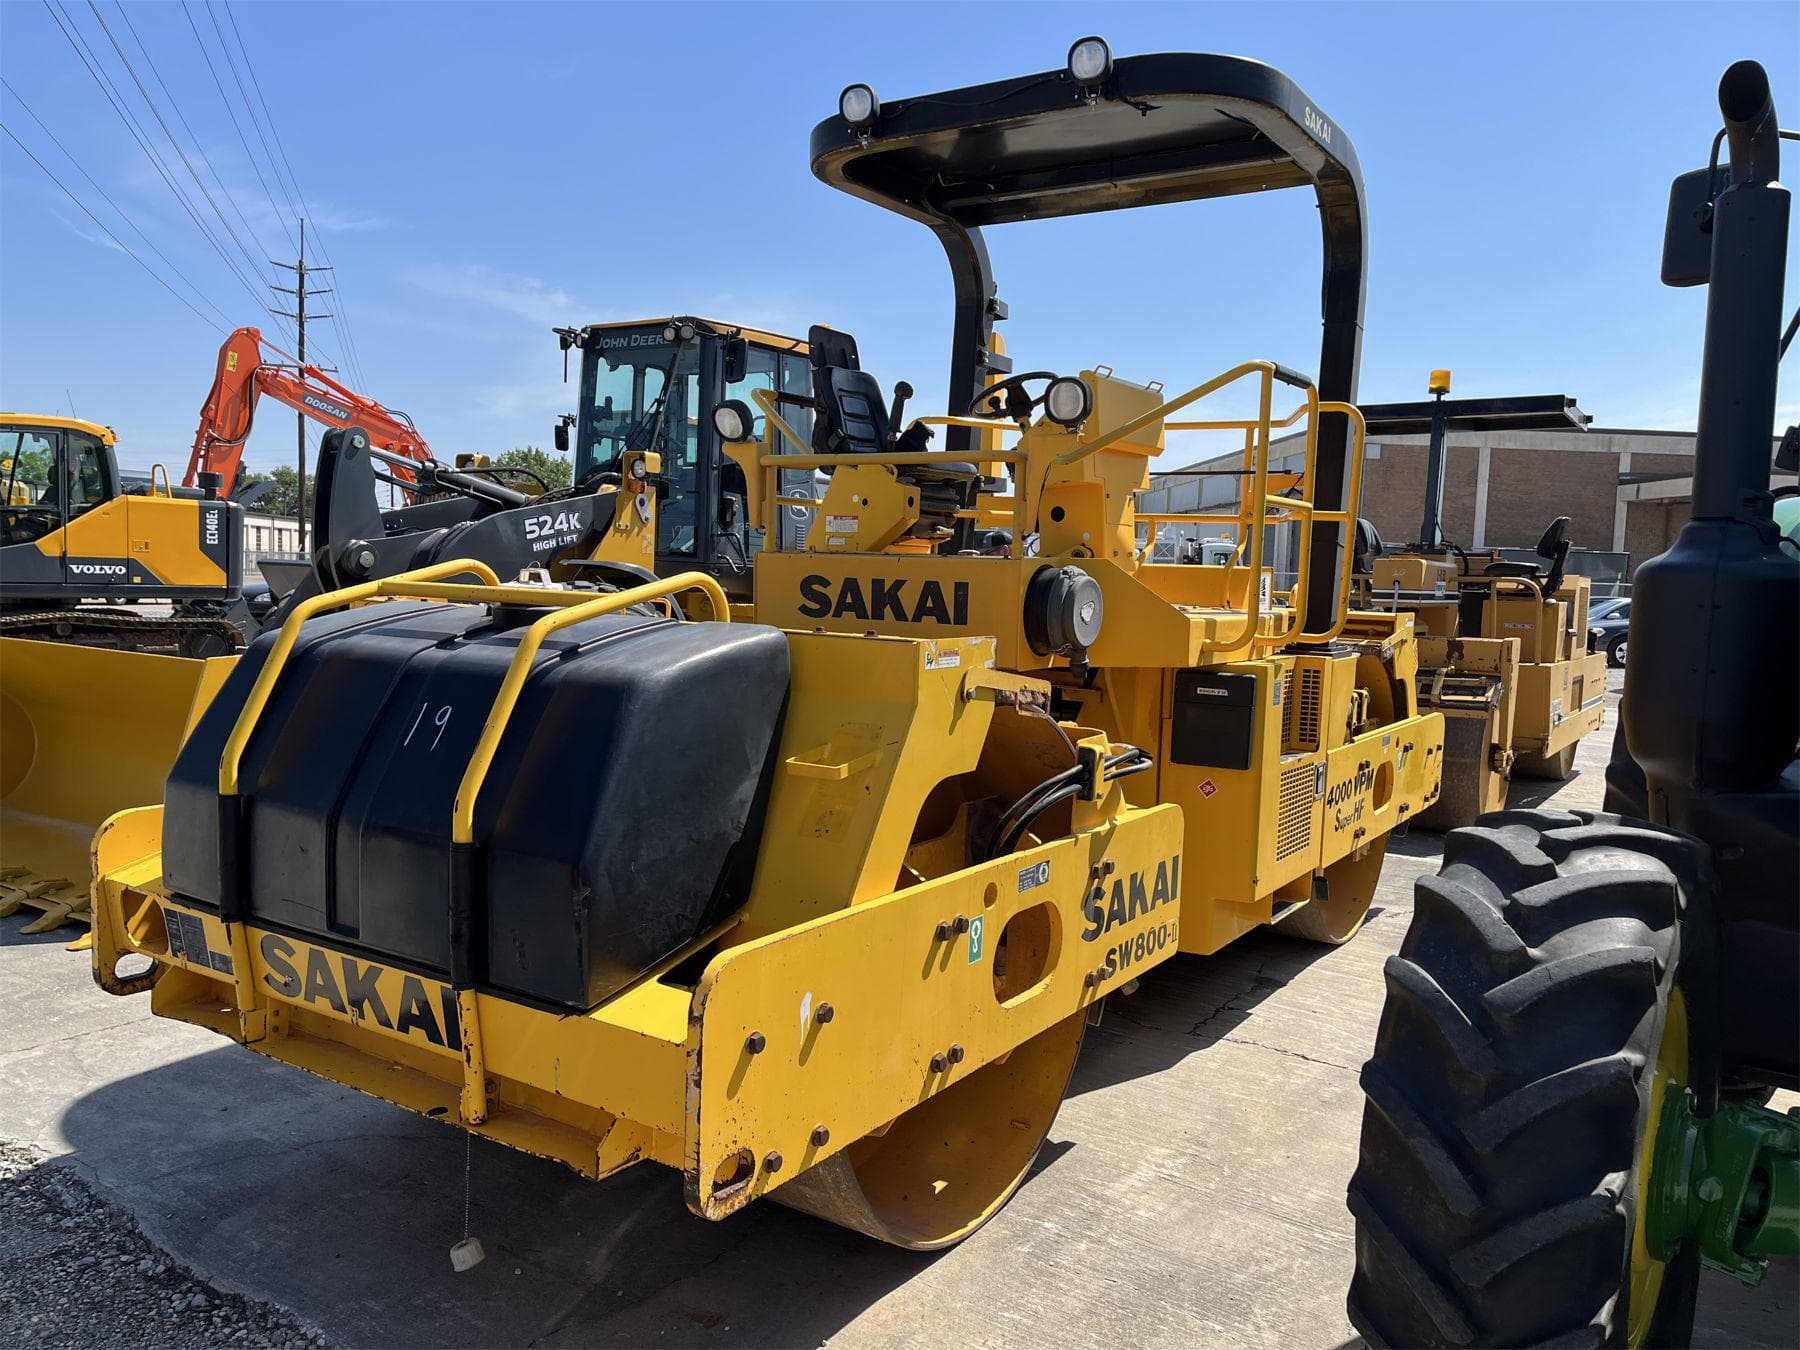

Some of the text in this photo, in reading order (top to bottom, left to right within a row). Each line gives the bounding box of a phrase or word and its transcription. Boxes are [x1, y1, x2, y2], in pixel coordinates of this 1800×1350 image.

[1304, 106, 1331, 144] SAKAI
[595, 336, 627, 349] JOHN
[304, 396, 348, 419] DOOSAN
[206, 509, 219, 545] EC140EL
[524, 512, 582, 540] 524K
[532, 534, 578, 552] HIGH LIFT
[69, 564, 127, 575] VOLVO
[797, 574, 969, 626] SAKAI
[403, 702, 452, 752] 19
[1327, 768, 1375, 809] 4000 VPM
[1081, 854, 1180, 942] SAKAI
[260, 934, 463, 1053] SAKAI
